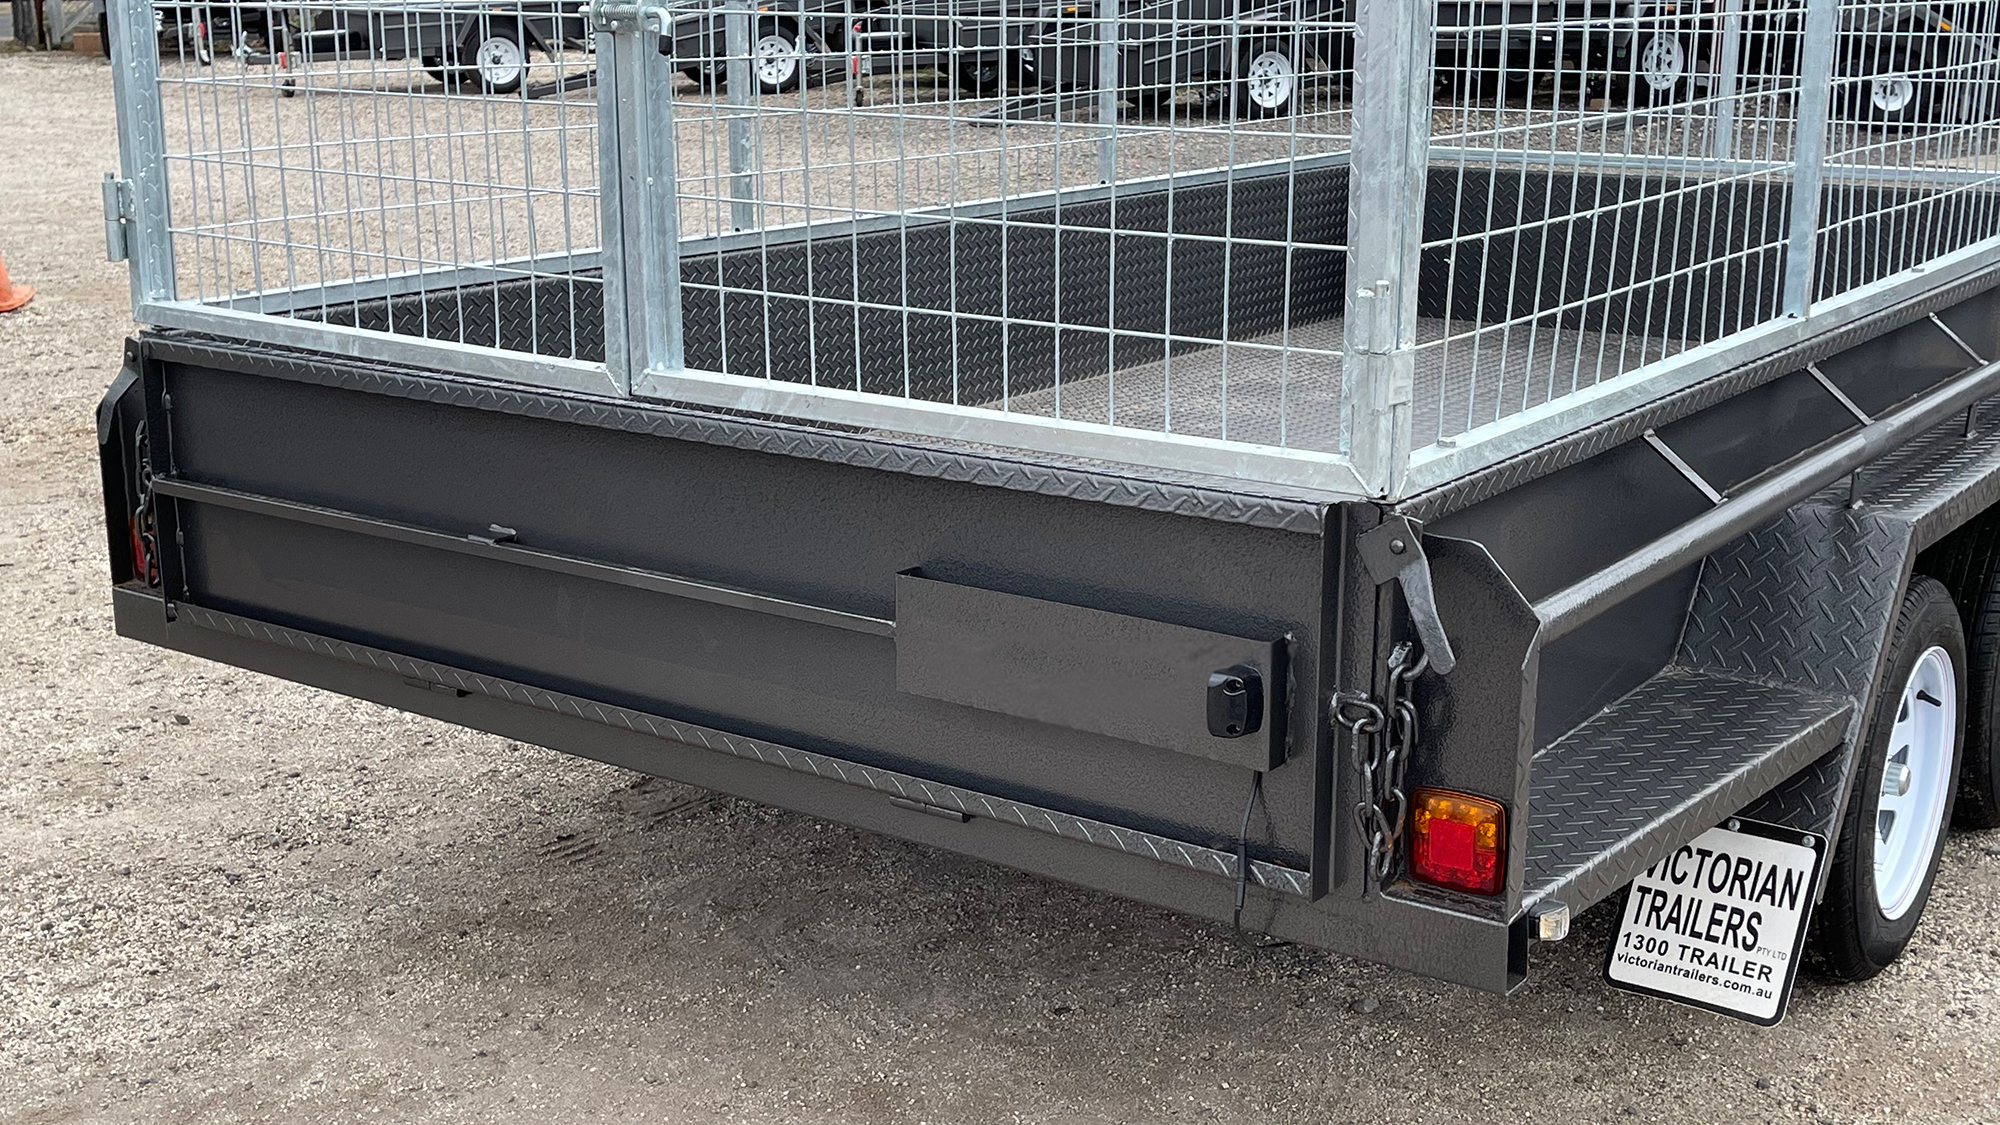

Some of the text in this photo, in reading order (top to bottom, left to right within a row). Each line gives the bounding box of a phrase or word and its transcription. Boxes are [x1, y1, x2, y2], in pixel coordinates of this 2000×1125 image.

[1633, 885, 1787, 961] TRAILERS PTY LTD
[1617, 952, 1773, 999] victoriantrailers.com.au
[1623, 932, 1773, 982] 1300 TRAILER
